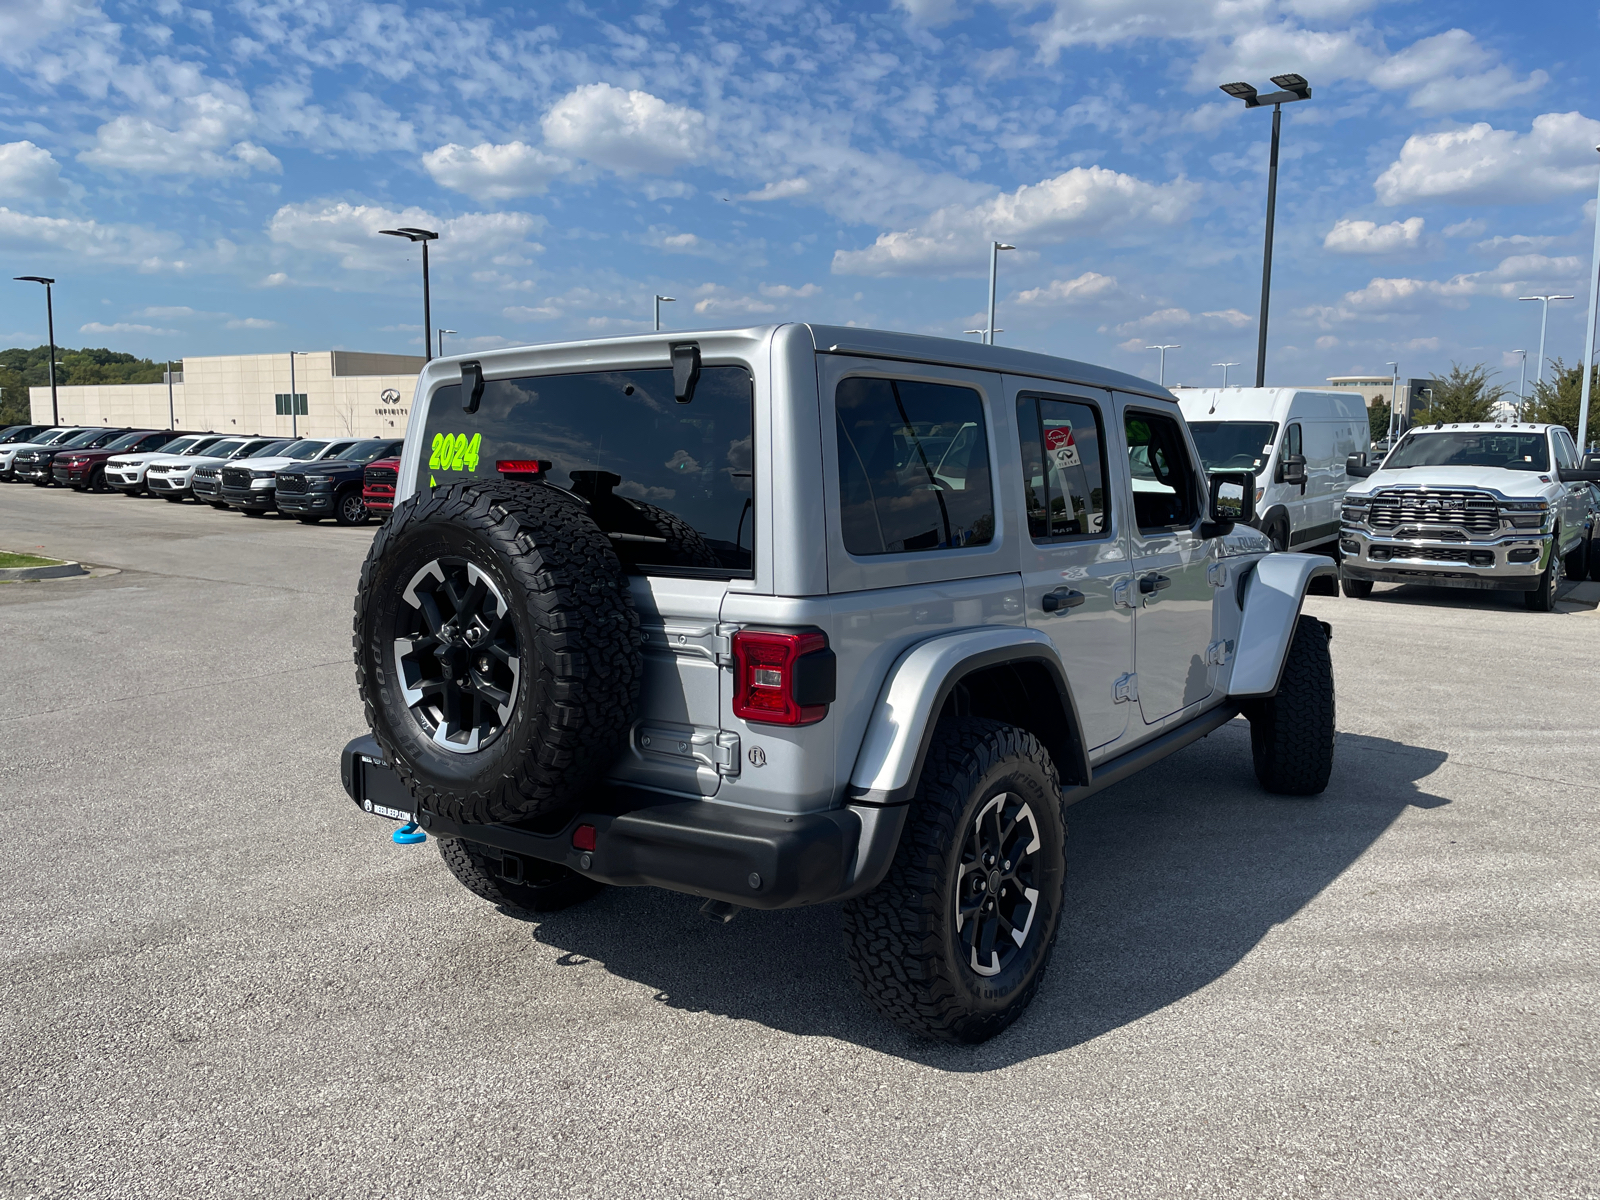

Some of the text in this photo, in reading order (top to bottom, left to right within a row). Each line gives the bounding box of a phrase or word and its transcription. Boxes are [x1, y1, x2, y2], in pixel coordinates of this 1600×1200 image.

[375, 408, 408, 416] INFINITI
[429, 433, 482, 472] 2024
[1401, 499, 1464, 509] RAM
